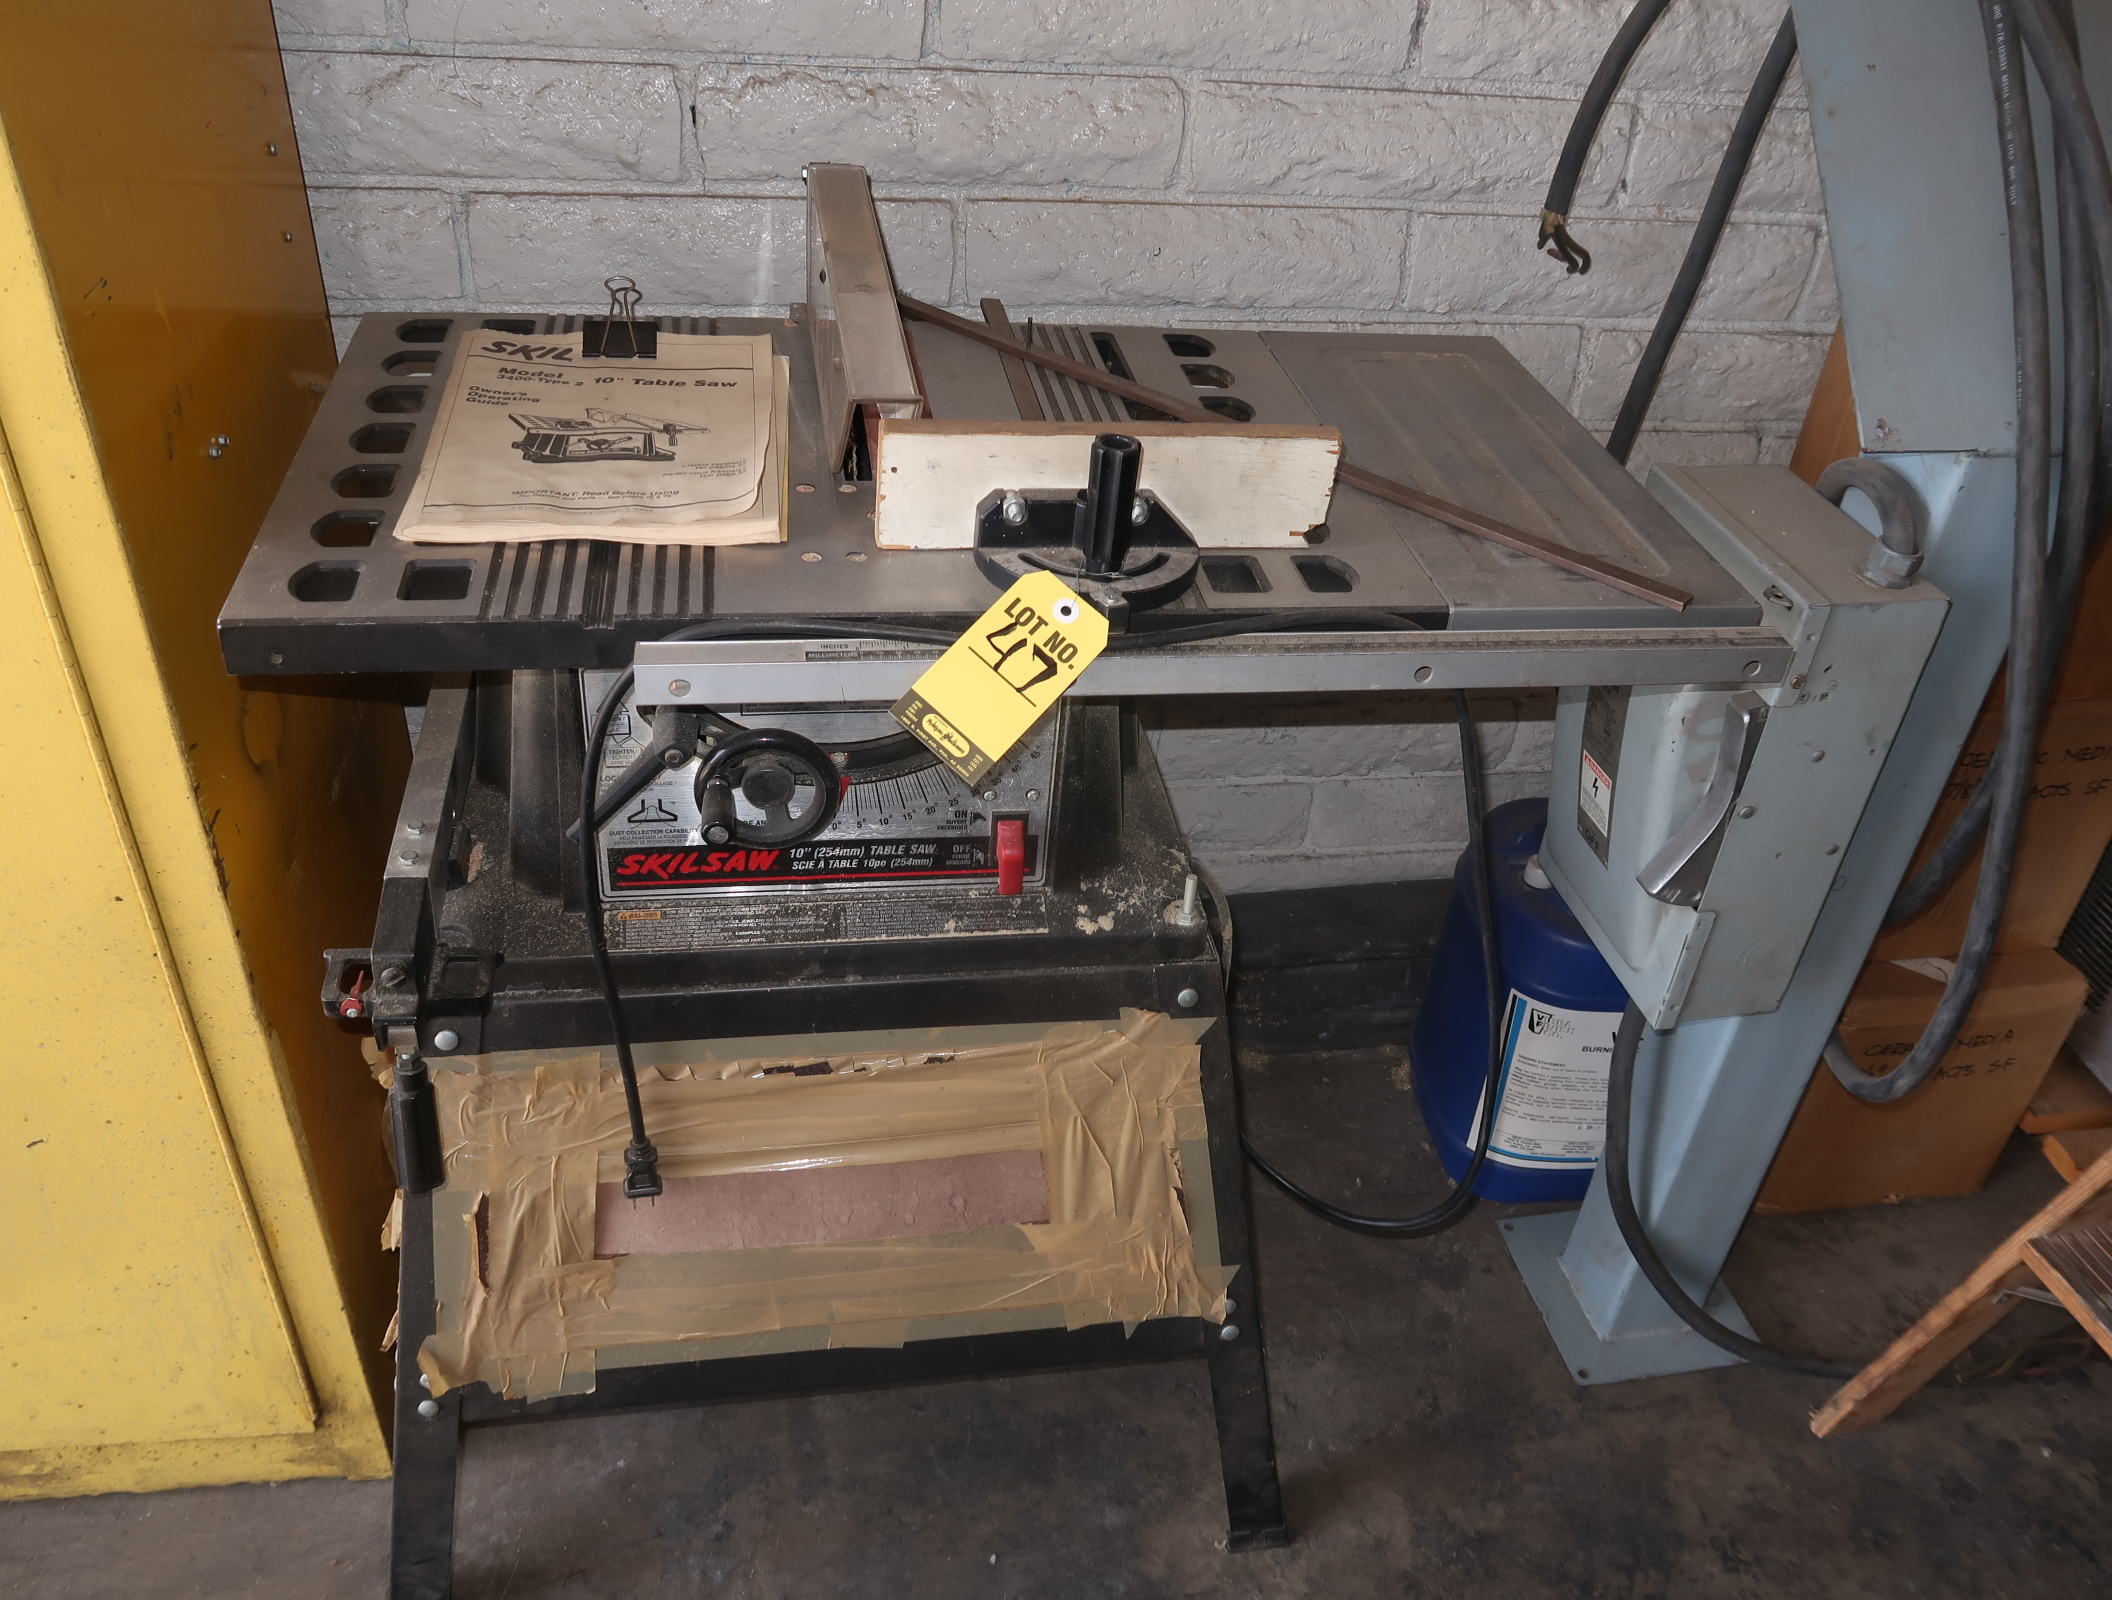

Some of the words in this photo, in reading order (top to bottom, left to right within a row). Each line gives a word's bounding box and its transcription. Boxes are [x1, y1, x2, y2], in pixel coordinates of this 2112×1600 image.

[481, 341, 573, 361] SKIL
[498, 367, 564, 379] Model
[496, 374, 570, 385] 3400-Type
[632, 378, 686, 386] Table
[467, 391, 540, 403] Operating
[469, 386, 527, 396] Owner's
[466, 397, 509, 406] Guide
[511, 489, 578, 497] IMPORTANT:
[1003, 596, 1050, 637] LOT
[1042, 630, 1079, 671] NO.
[985, 621, 1058, 693] 47
[954, 810, 968, 819] ON
[1584, 828, 1600, 850] OFF
[814, 846, 865, 858] (254mm)
[871, 845, 905, 856] TABLE
[909, 843, 936, 855] SAW
[953, 844, 970, 854] OFF
[616, 849, 779, 880] SKILSAW
[792, 860, 815, 870] SCIE
[817, 857, 827, 869] À
[828, 859, 858, 869] TABLE
[863, 859, 886, 869] 10po
[890, 857, 933, 868] (254mm)
